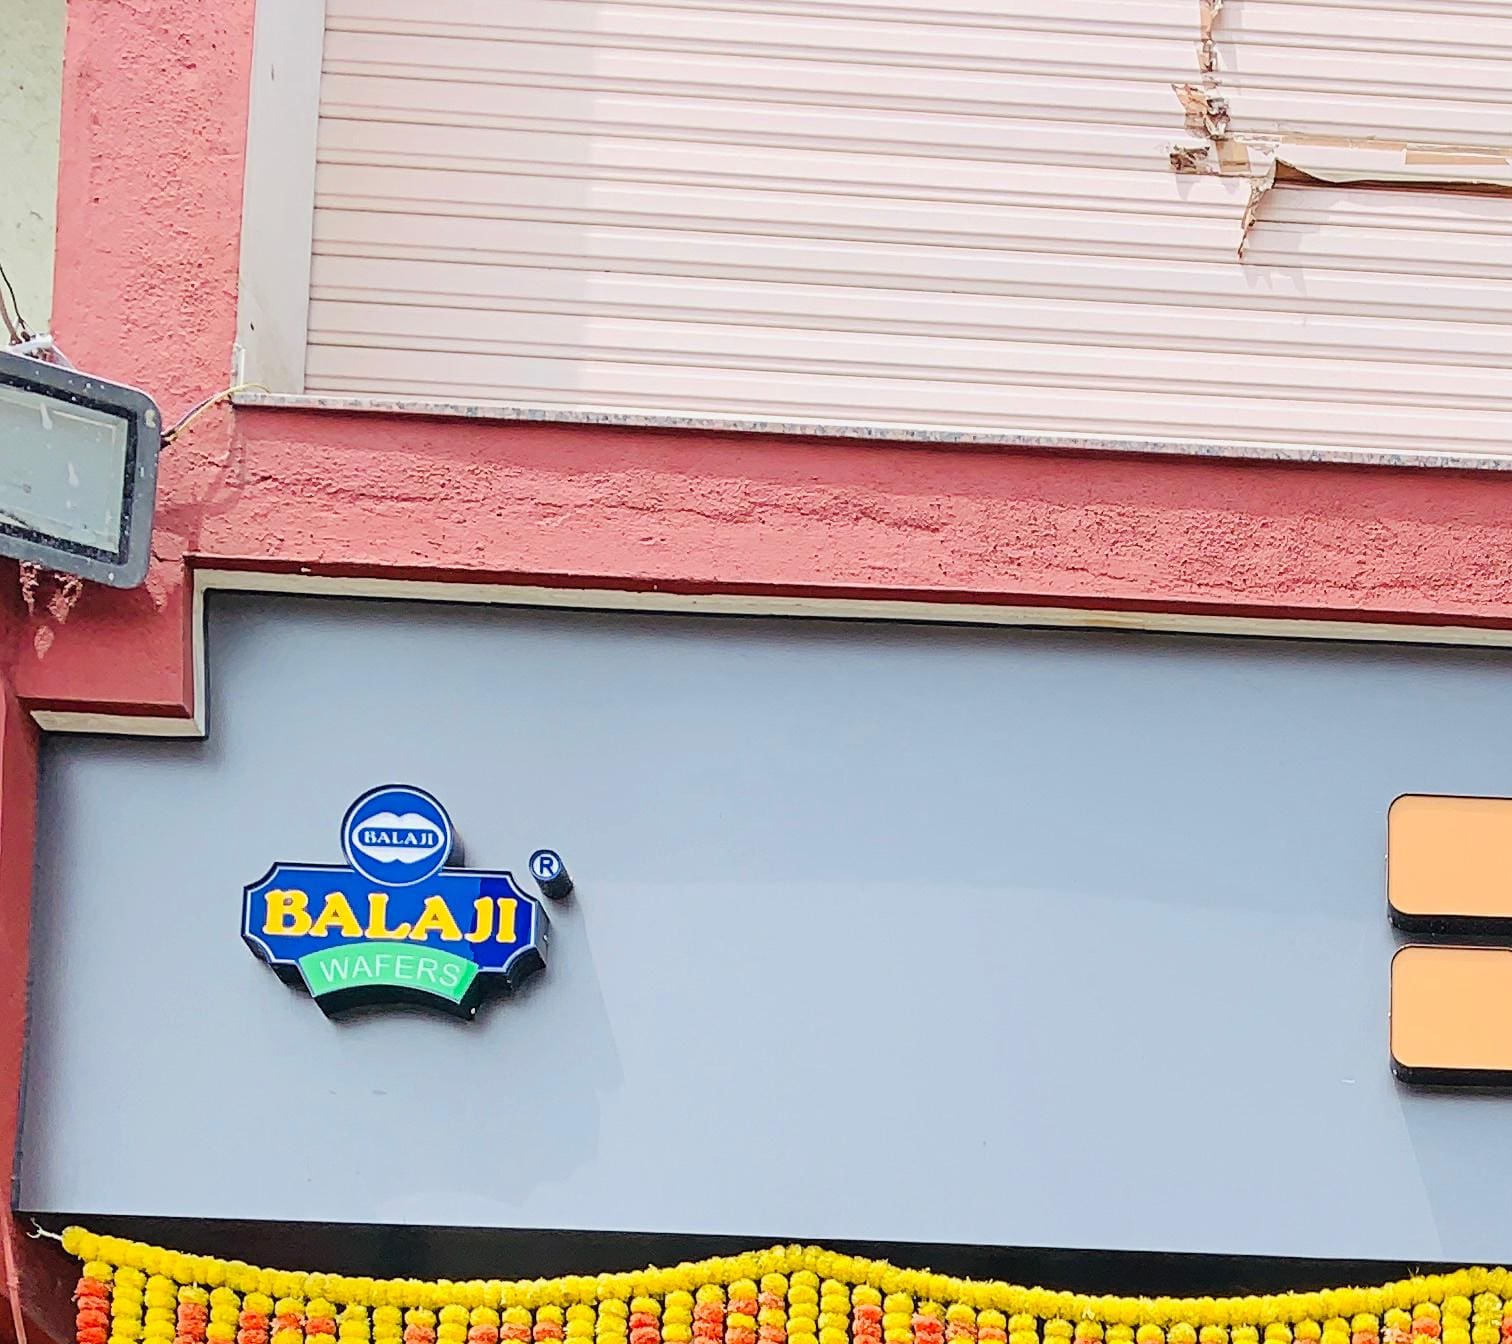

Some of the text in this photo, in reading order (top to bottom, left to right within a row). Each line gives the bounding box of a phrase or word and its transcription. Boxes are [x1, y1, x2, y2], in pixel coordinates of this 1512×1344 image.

[364, 830, 435, 847] BALAJI
[263, 890, 518, 943] BALAJI
[319, 953, 462, 988] WAFERS
